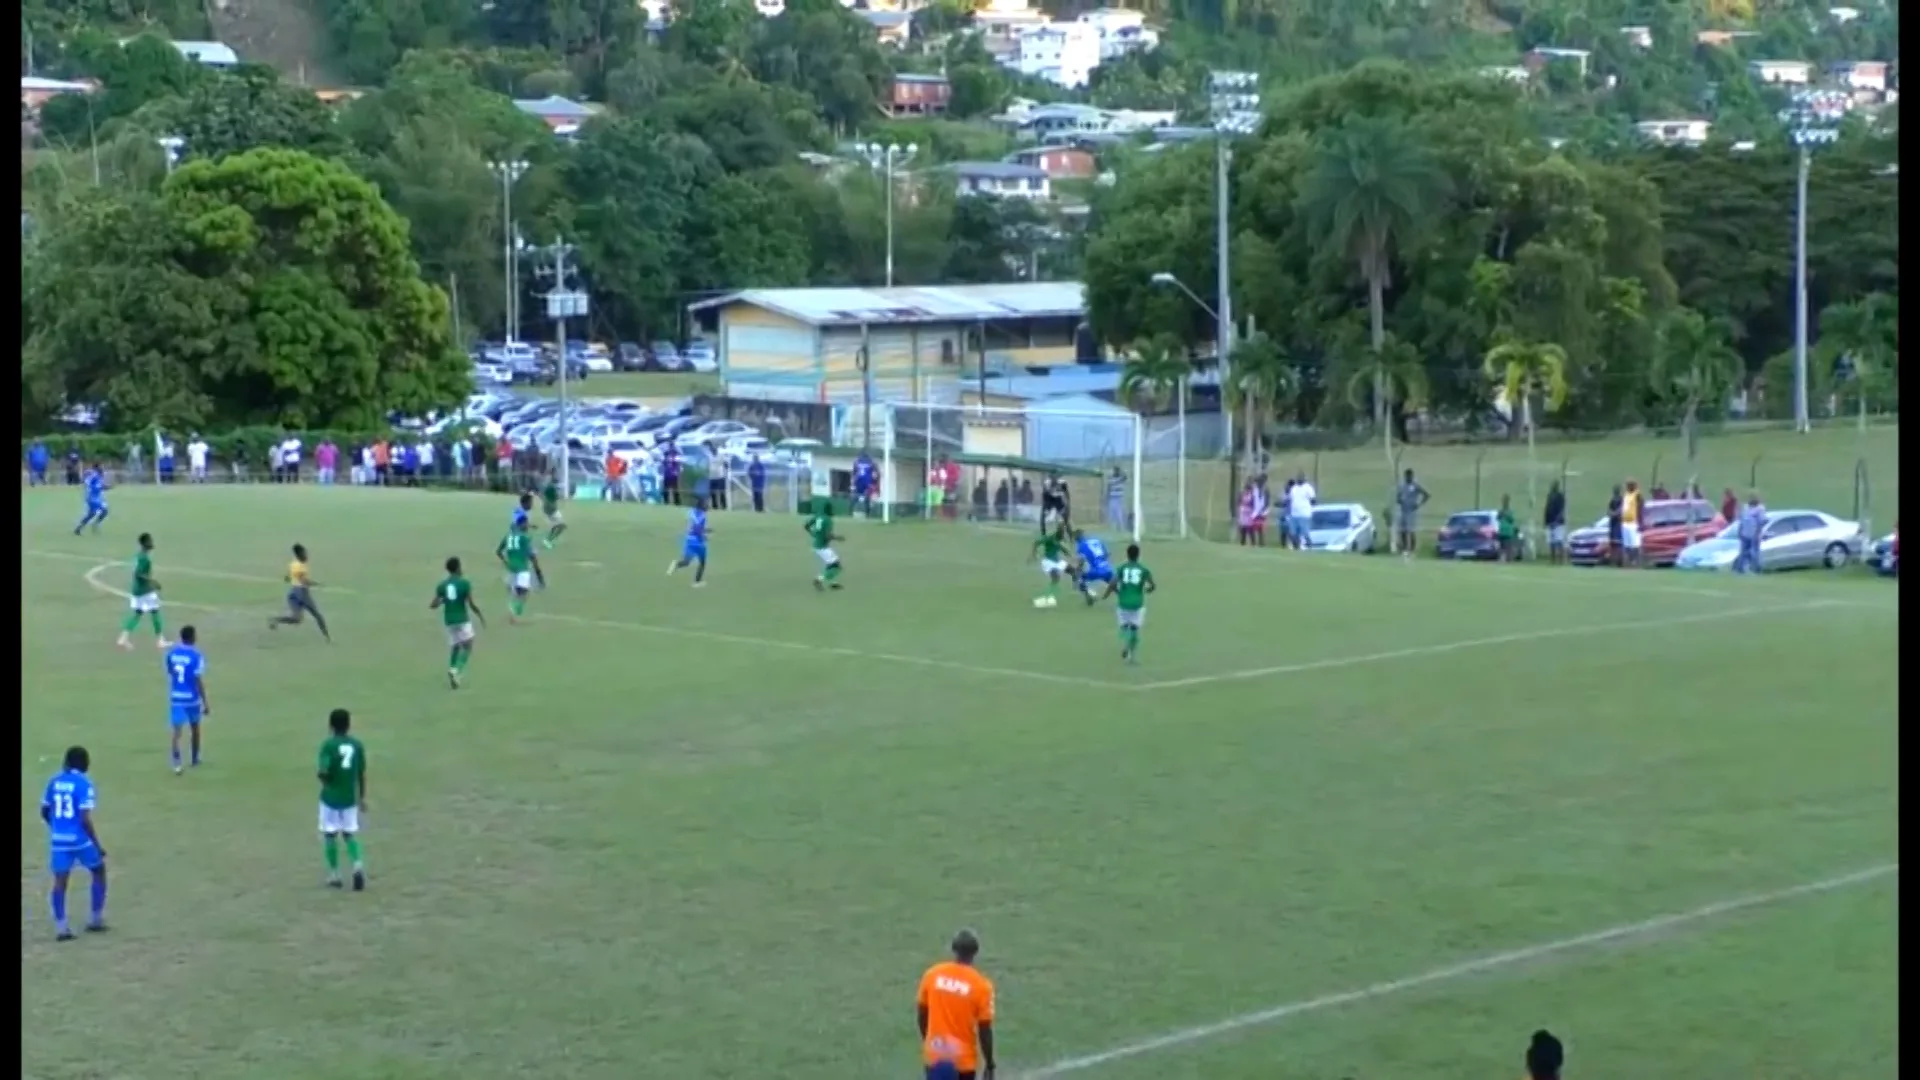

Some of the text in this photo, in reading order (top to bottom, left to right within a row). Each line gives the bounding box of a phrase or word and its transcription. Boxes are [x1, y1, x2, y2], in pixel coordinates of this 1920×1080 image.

[174, 664, 185, 684] 7
[338, 743, 354, 770] 7
[54, 793, 75, 819] 13
